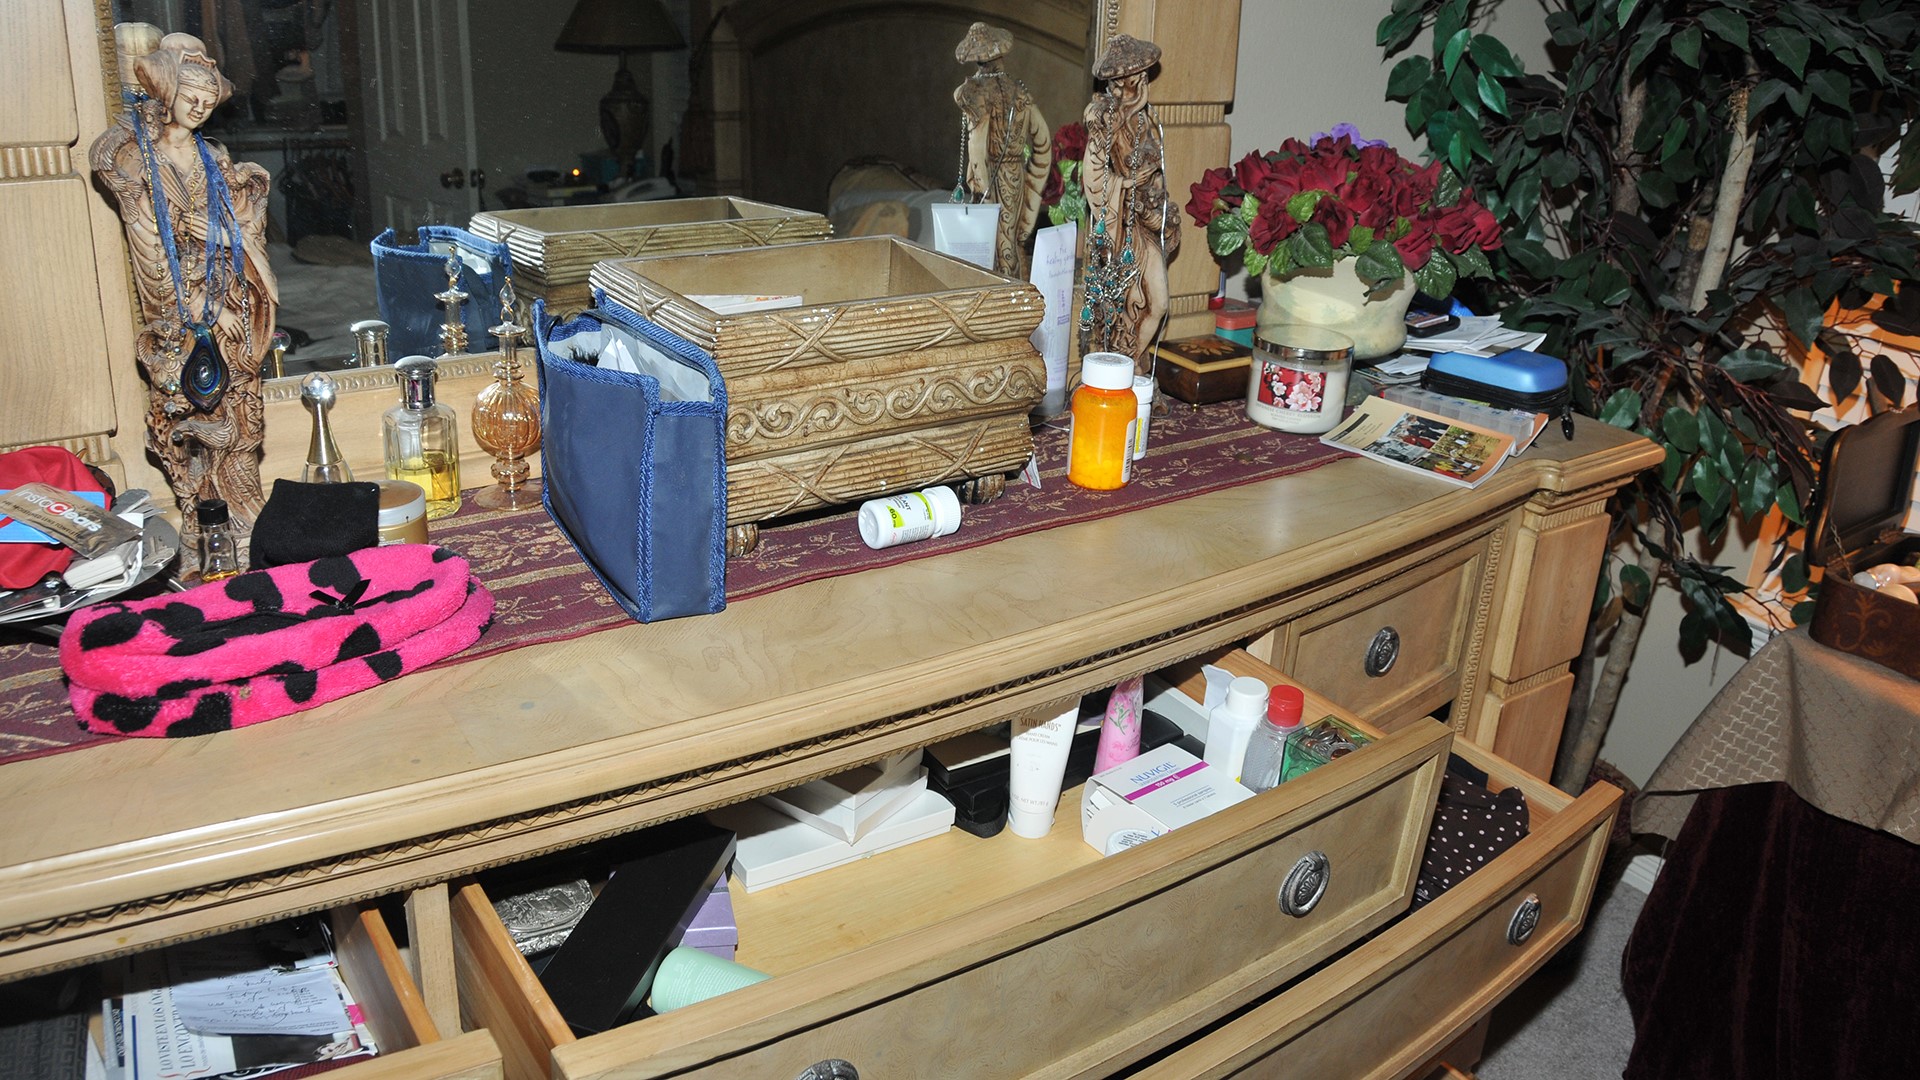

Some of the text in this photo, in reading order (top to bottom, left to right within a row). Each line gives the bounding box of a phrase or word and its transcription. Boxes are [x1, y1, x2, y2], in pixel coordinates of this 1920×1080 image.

[1020, 717, 1038, 728] SATIN
[1130, 761, 1177, 784] NUVIGIL
[152, 1007, 166, 1023] LOS
[155, 1023, 168, 1035] EN
[157, 1036, 171, 1060] VISTE
[160, 1059, 173, 1071] LO
[180, 1056, 196, 1069] LO
